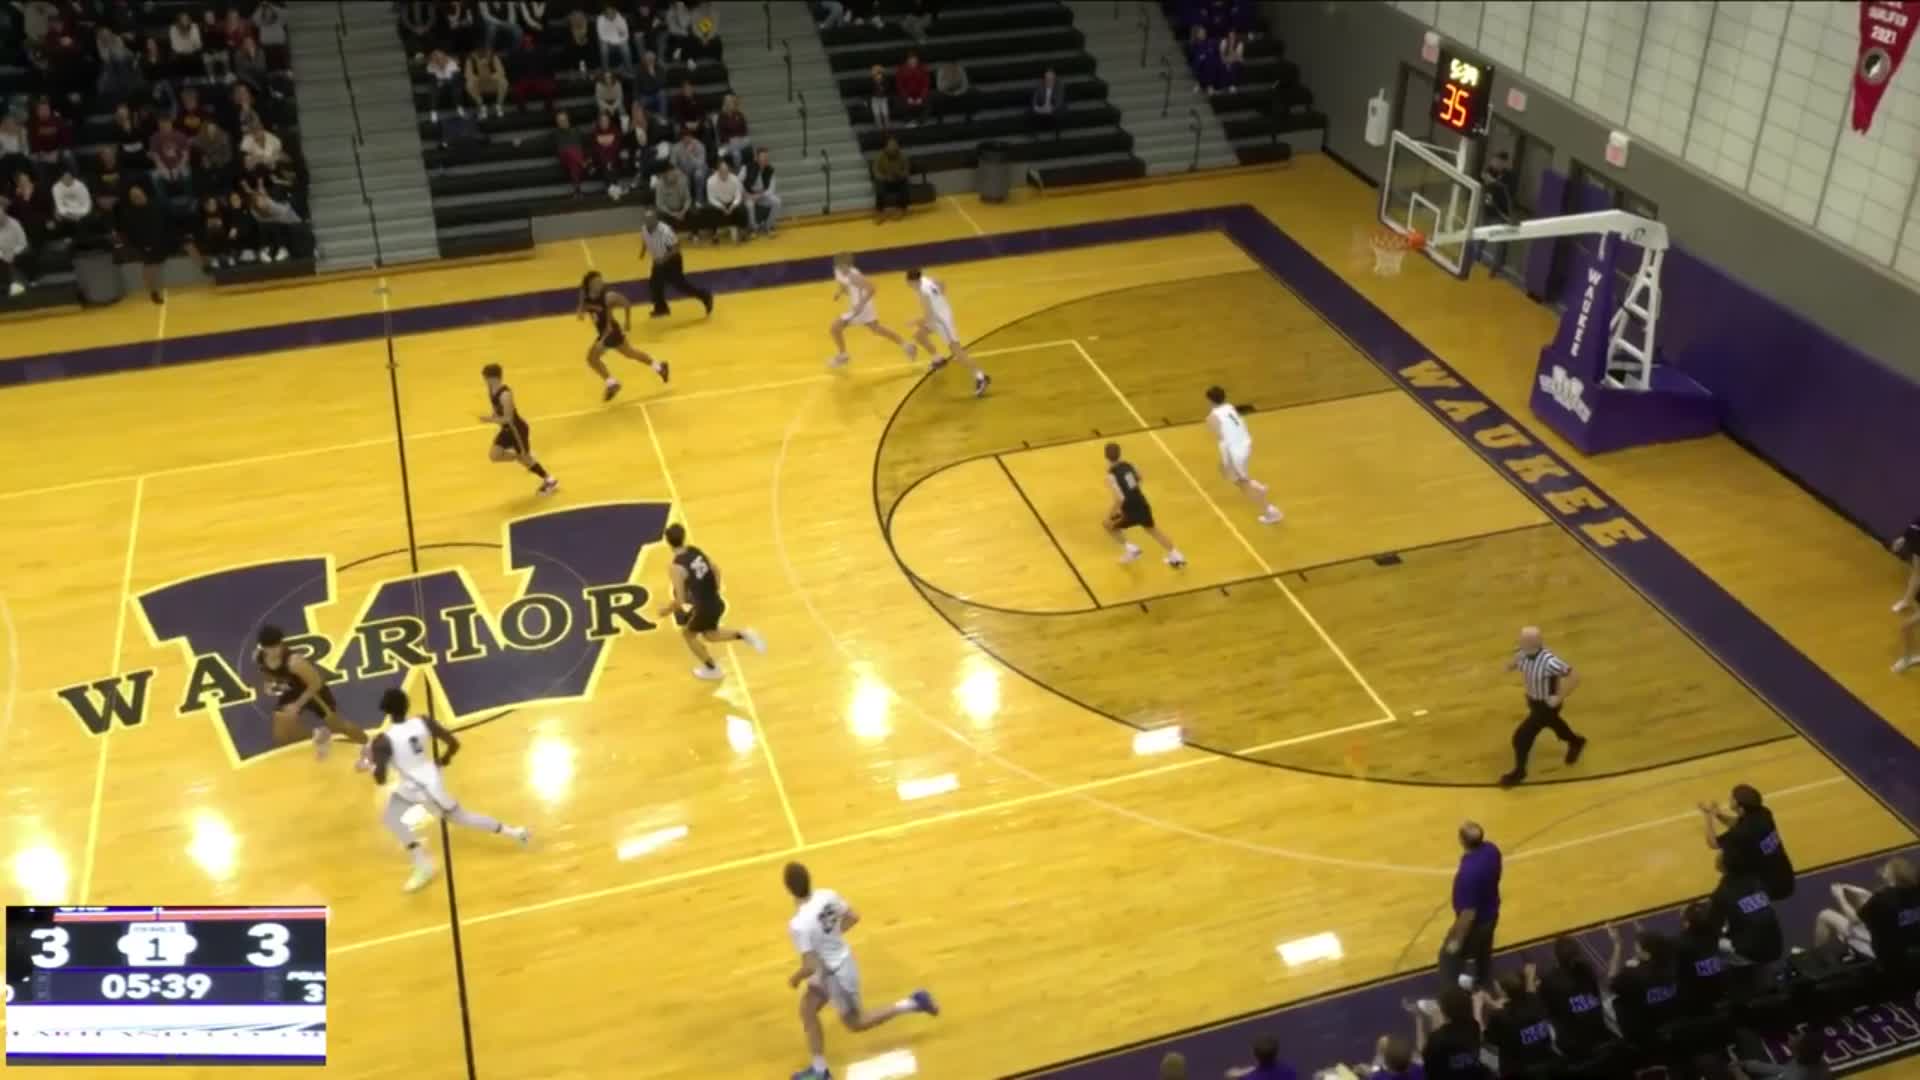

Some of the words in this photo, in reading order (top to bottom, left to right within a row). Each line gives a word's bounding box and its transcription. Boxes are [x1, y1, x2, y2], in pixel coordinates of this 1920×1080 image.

[1439, 83, 1470, 128] 35
[1569, 267, 1603, 358] WAUKEE
[1397, 359, 1648, 548] WAUKEE
